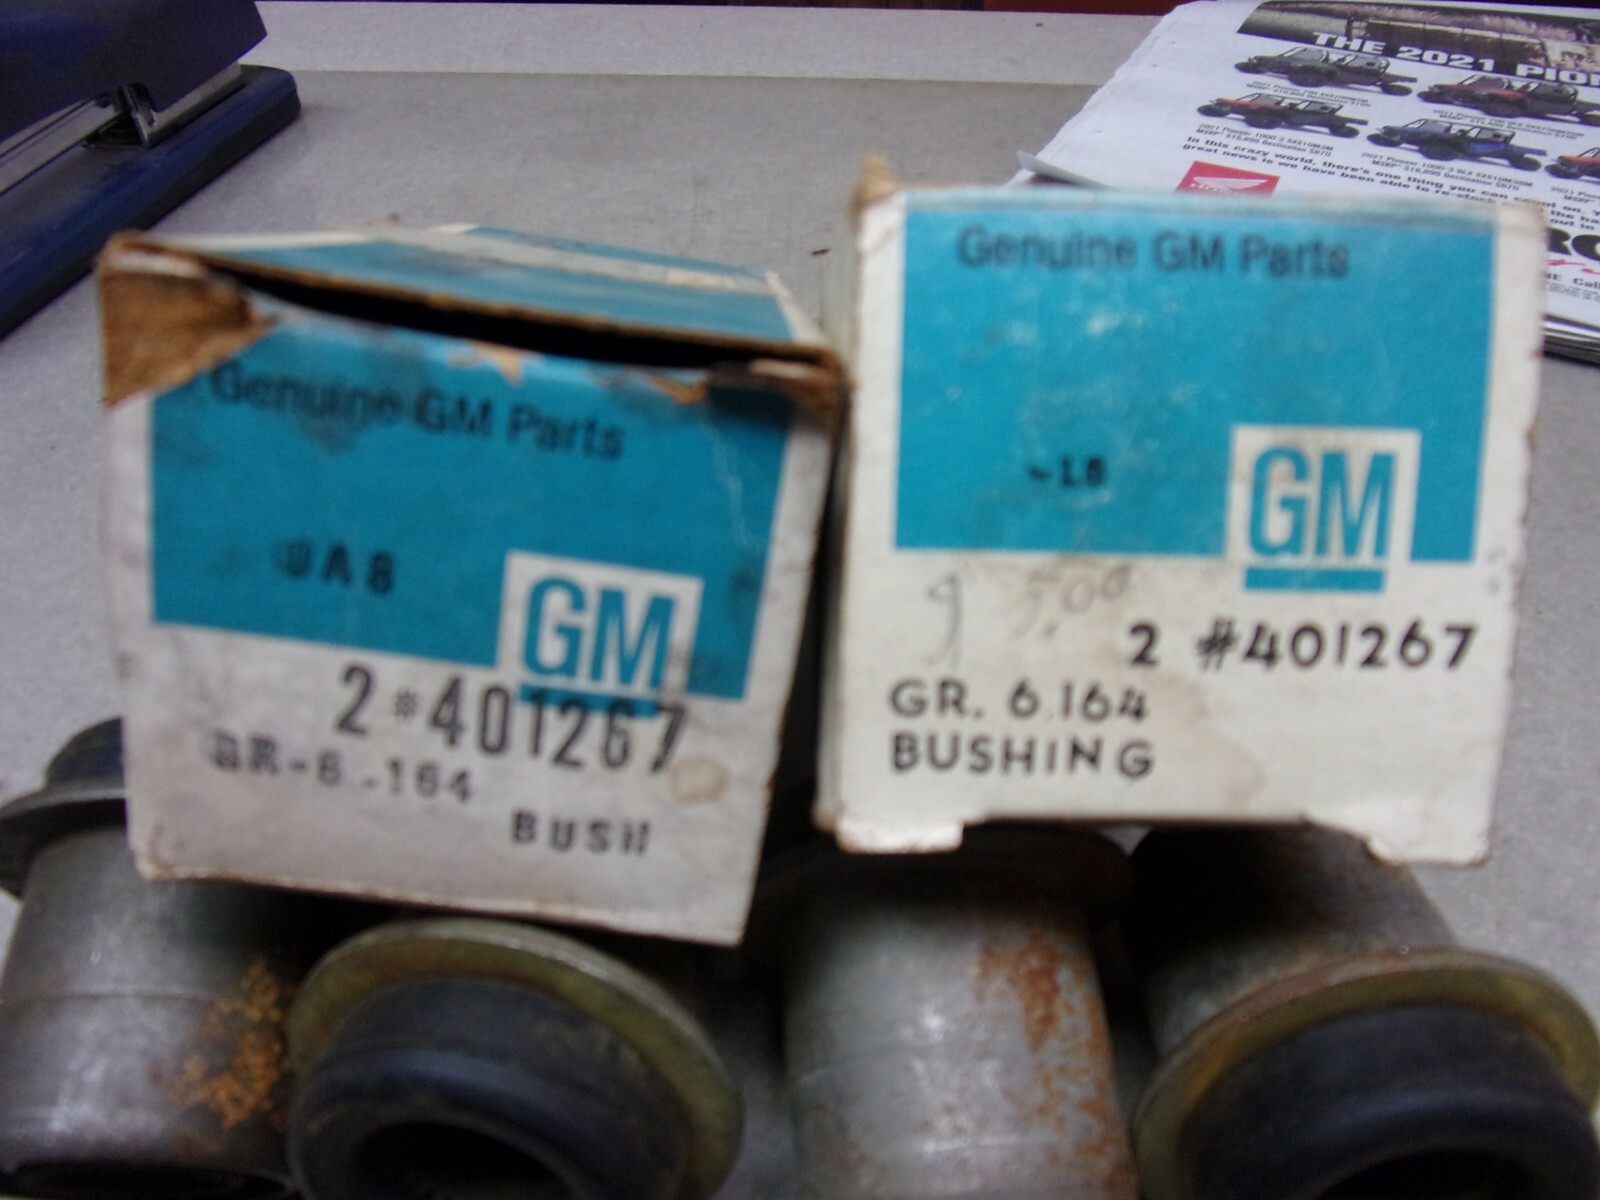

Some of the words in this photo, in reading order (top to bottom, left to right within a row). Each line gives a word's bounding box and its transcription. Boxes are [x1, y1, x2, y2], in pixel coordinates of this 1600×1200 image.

[1312, 31, 1386, 56] THE
[1396, 45, 1496, 72] 2021
[1182, 143, 1218, 154] great
[1222, 150, 1258, 162] news
[1262, 156, 1274, 165] is
[1278, 161, 1298, 170] we
[1302, 165, 1336, 176] have
[1340, 172, 1375, 183] been
[1380, 179, 1410, 190] able
[1415, 184, 1430, 193] to
[1205, 139, 1230, 149] this
[1233, 144, 1270, 157] crazy
[1274, 152, 1316, 166] world,
[1322, 160, 1371, 175] there's
[1375, 171, 1402, 181] one
[1407, 175, 1444, 189] thing
[1450, 185, 1476, 195] you
[1481, 190, 1508, 200] can
[958, 226, 1137, 273] Genuine
[1153, 227, 1226, 275] GM
[1240, 235, 1352, 280] Parts
[210, 361, 401, 426] Genuine
[412, 386, 493, 439] GM
[505, 403, 626, 461] Parts
[1249, 446, 1397, 559] GM
[523, 577, 675, 691] GM
[1130, 621, 1160, 668] 2
[1196, 621, 1480, 672] #401267
[888, 677, 985, 719] GR.
[891, 730, 1154, 782] BUSHING
